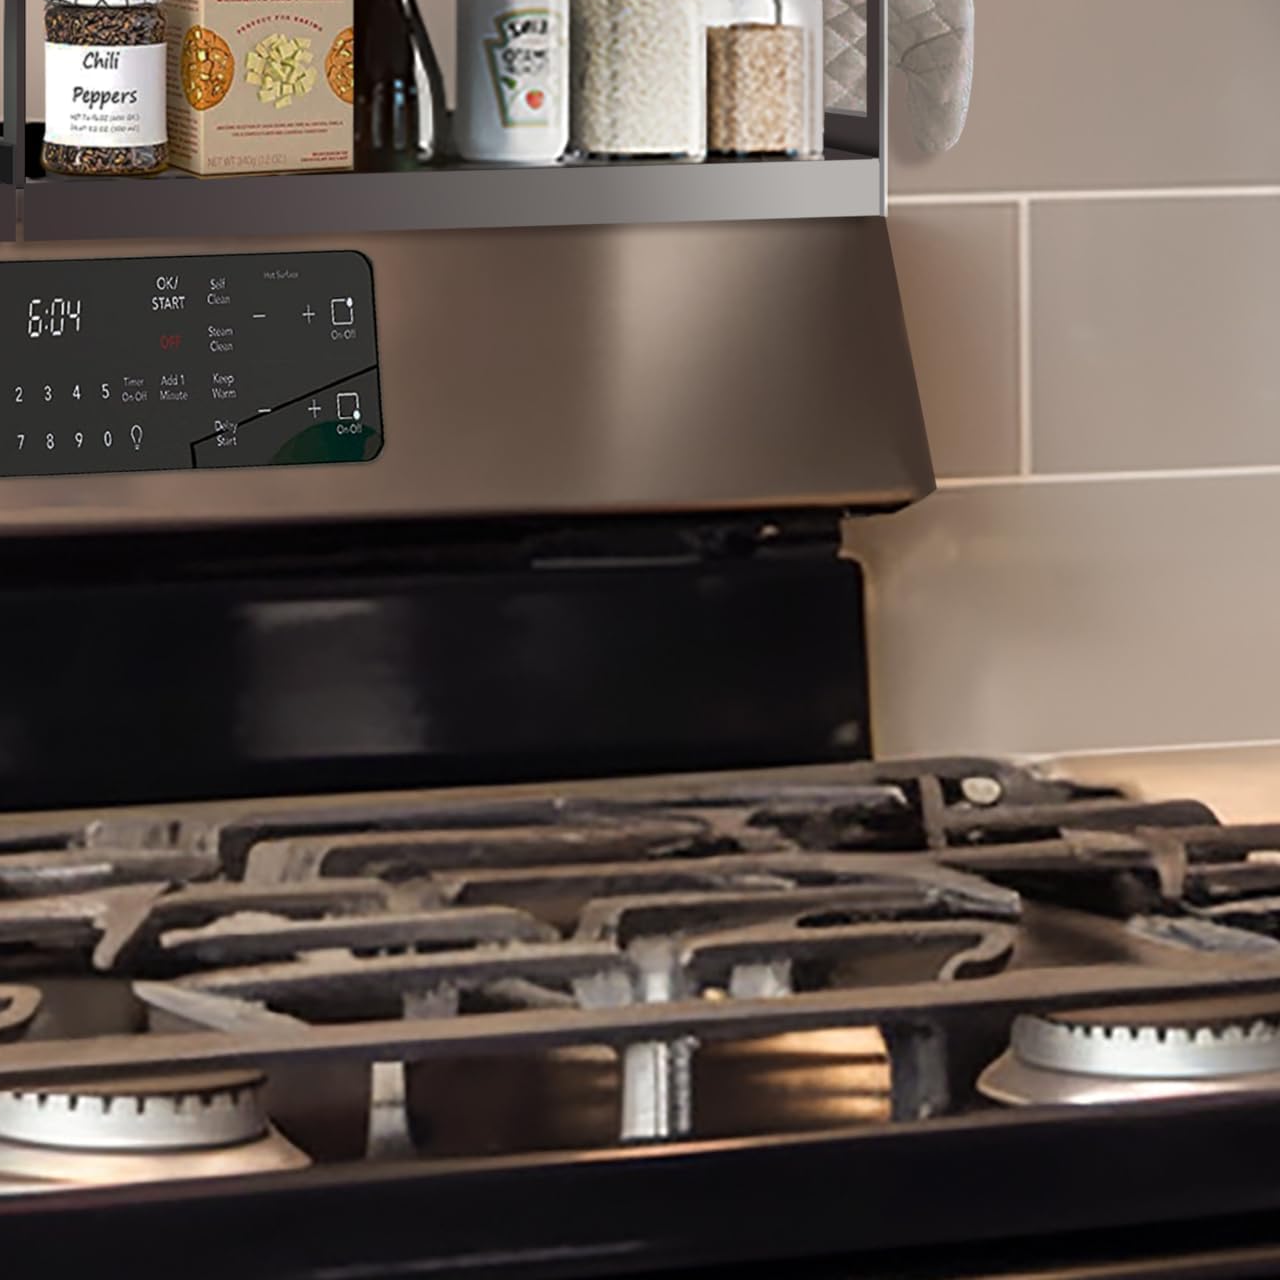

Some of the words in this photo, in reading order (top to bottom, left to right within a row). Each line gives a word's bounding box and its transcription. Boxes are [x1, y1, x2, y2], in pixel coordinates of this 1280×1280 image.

[82, 51, 120, 69] Chili
[72, 86, 138, 109] Peppers
[156, 276, 179, 290] OK/
[152, 296, 185, 310] START
[28, 298, 81, 338] 6:04
[160, 335, 182, 350] OFF
[161, 374, 179, 386] Add
[15, 386, 23, 403] 2
[44, 385, 52, 401] 3
[72, 384, 81, 400] 4
[101, 383, 110, 399] 5
[17, 434, 25, 450] 7
[46, 432, 55, 450] 8
[74, 432, 84, 448] 9
[103, 431, 112, 447] 0
